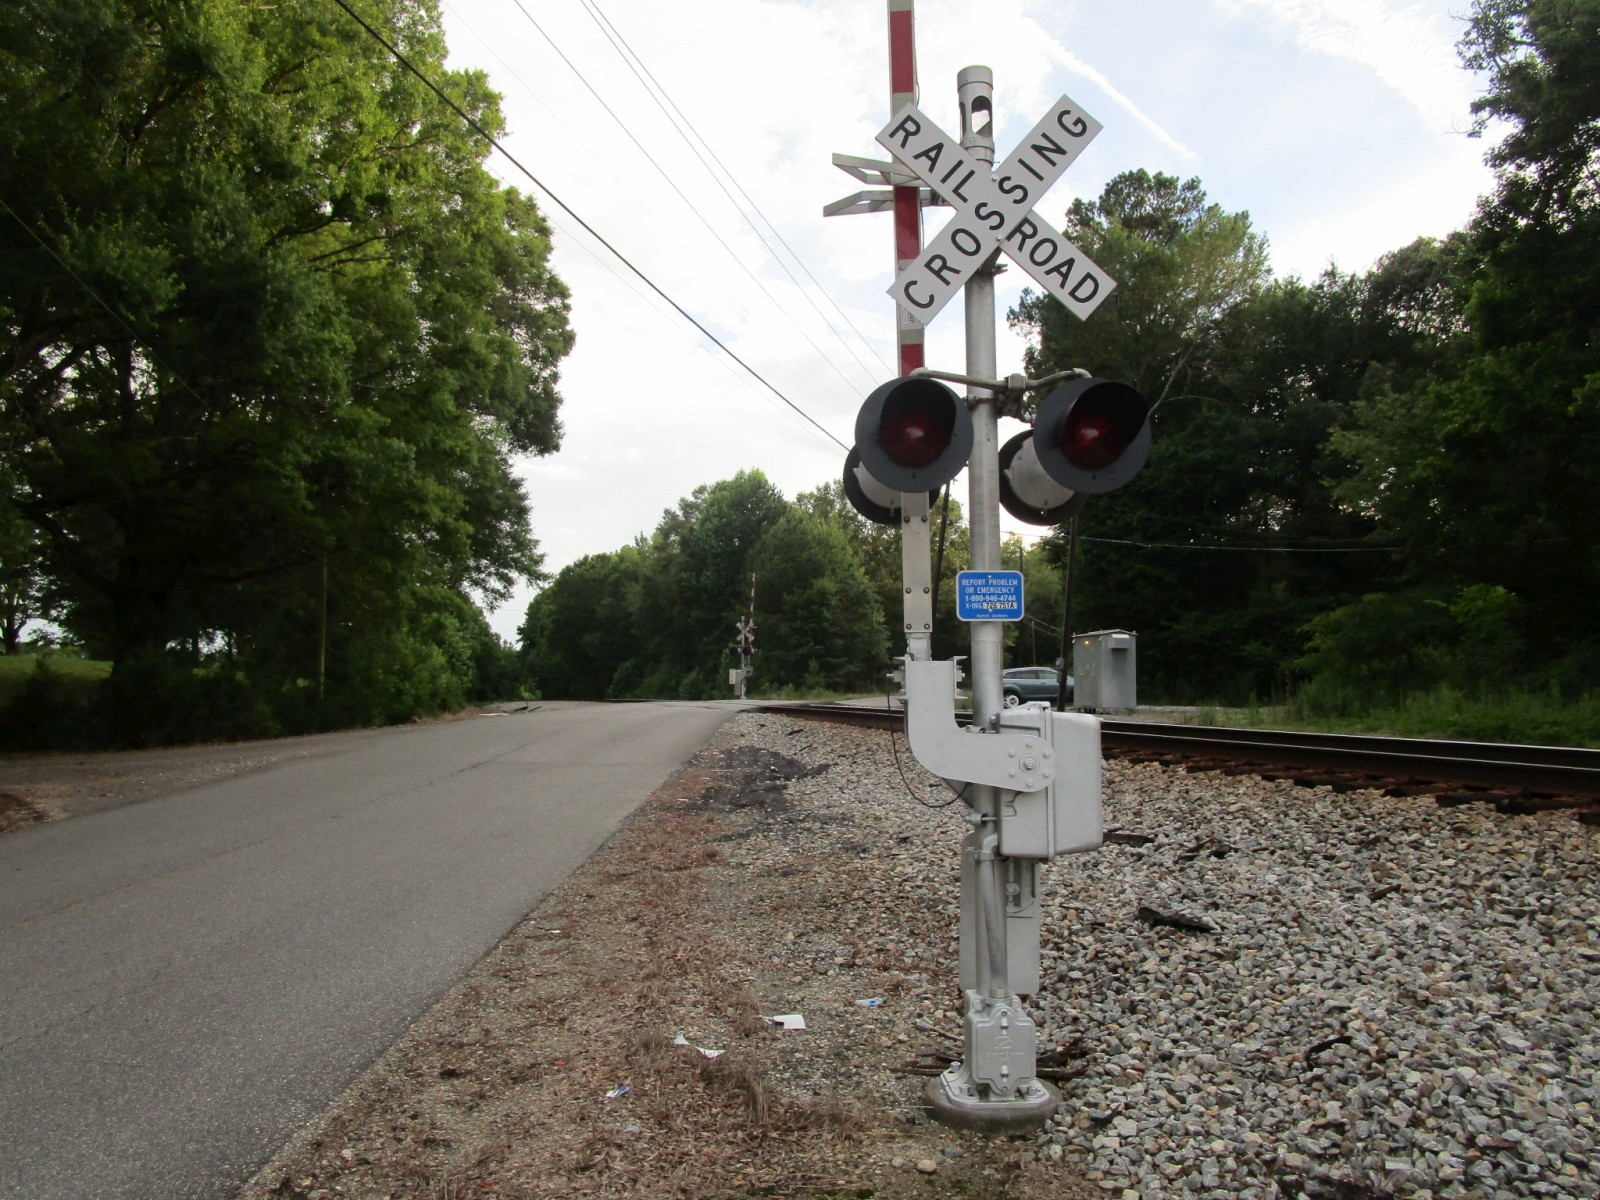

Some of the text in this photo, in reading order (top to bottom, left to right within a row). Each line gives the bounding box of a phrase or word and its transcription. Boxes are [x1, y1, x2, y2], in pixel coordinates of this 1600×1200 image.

[888, 114, 1100, 304] RAIL ROAD
[903, 109, 1088, 309] CROSSING
